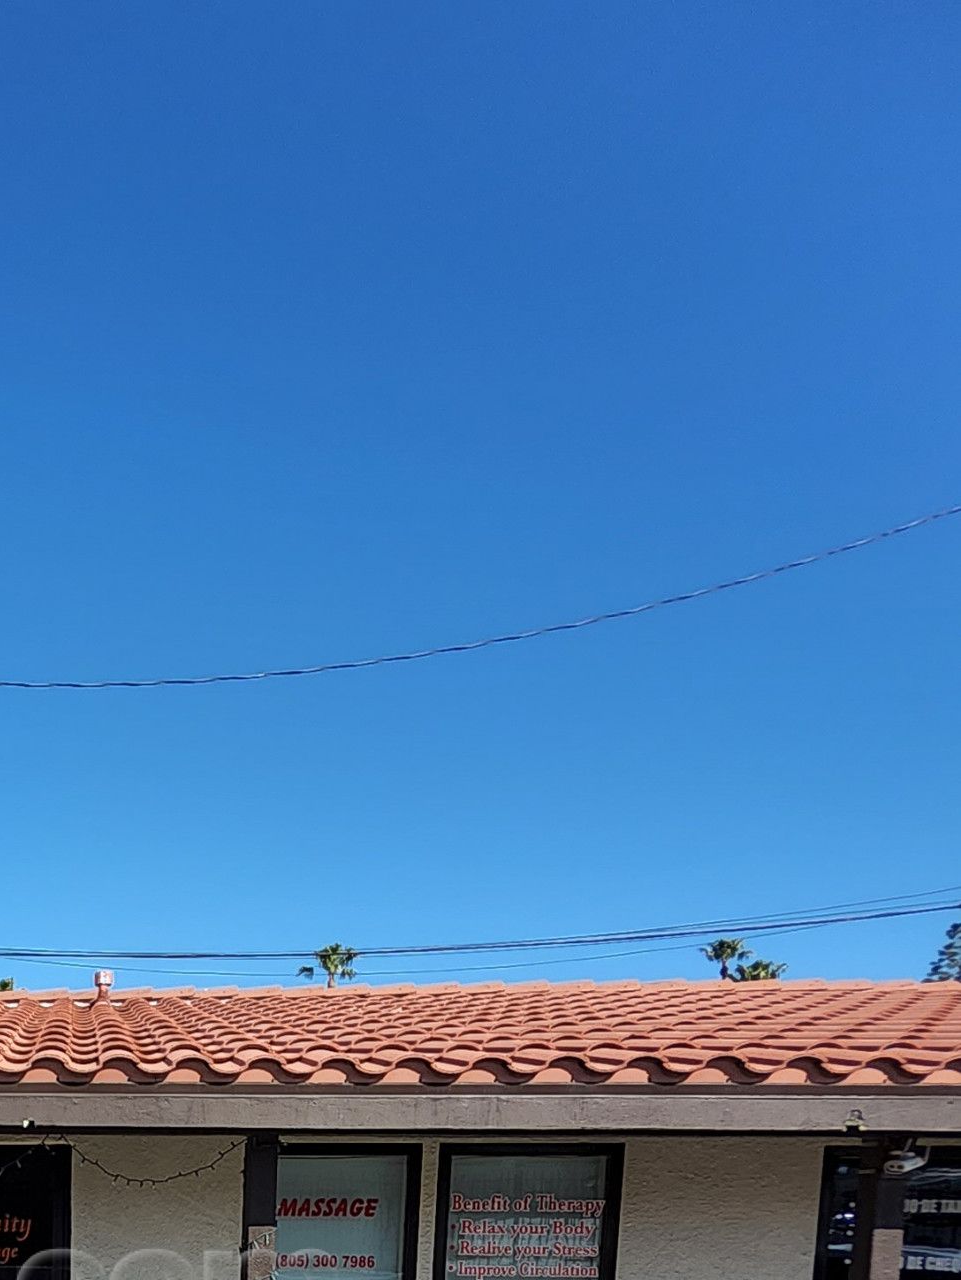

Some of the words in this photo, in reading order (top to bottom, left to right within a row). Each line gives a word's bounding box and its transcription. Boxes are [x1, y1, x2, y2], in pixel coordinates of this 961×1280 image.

[277, 1197, 379, 1218] MASSAGE
[450, 1193, 509, 1212] Benefit
[513, 1194, 531, 1212] of
[537, 1193, 605, 1217] Therapy
[460, 1219, 506, 1236] Relax
[511, 1224, 548, 1239] your
[552, 1220, 597, 1239] Body
[276, 1252, 309, 1270] (805)
[312, 1254, 337, 1269] 300
[341, 1255, 376, 1269] 7986
[458, 1240, 513, 1257] Realive
[516, 1246, 551, 1262] your
[553, 1241, 600, 1257] Stress
[457, 1261, 516, 1280] Improve
[519, 1262, 599, 1279] Circulation
